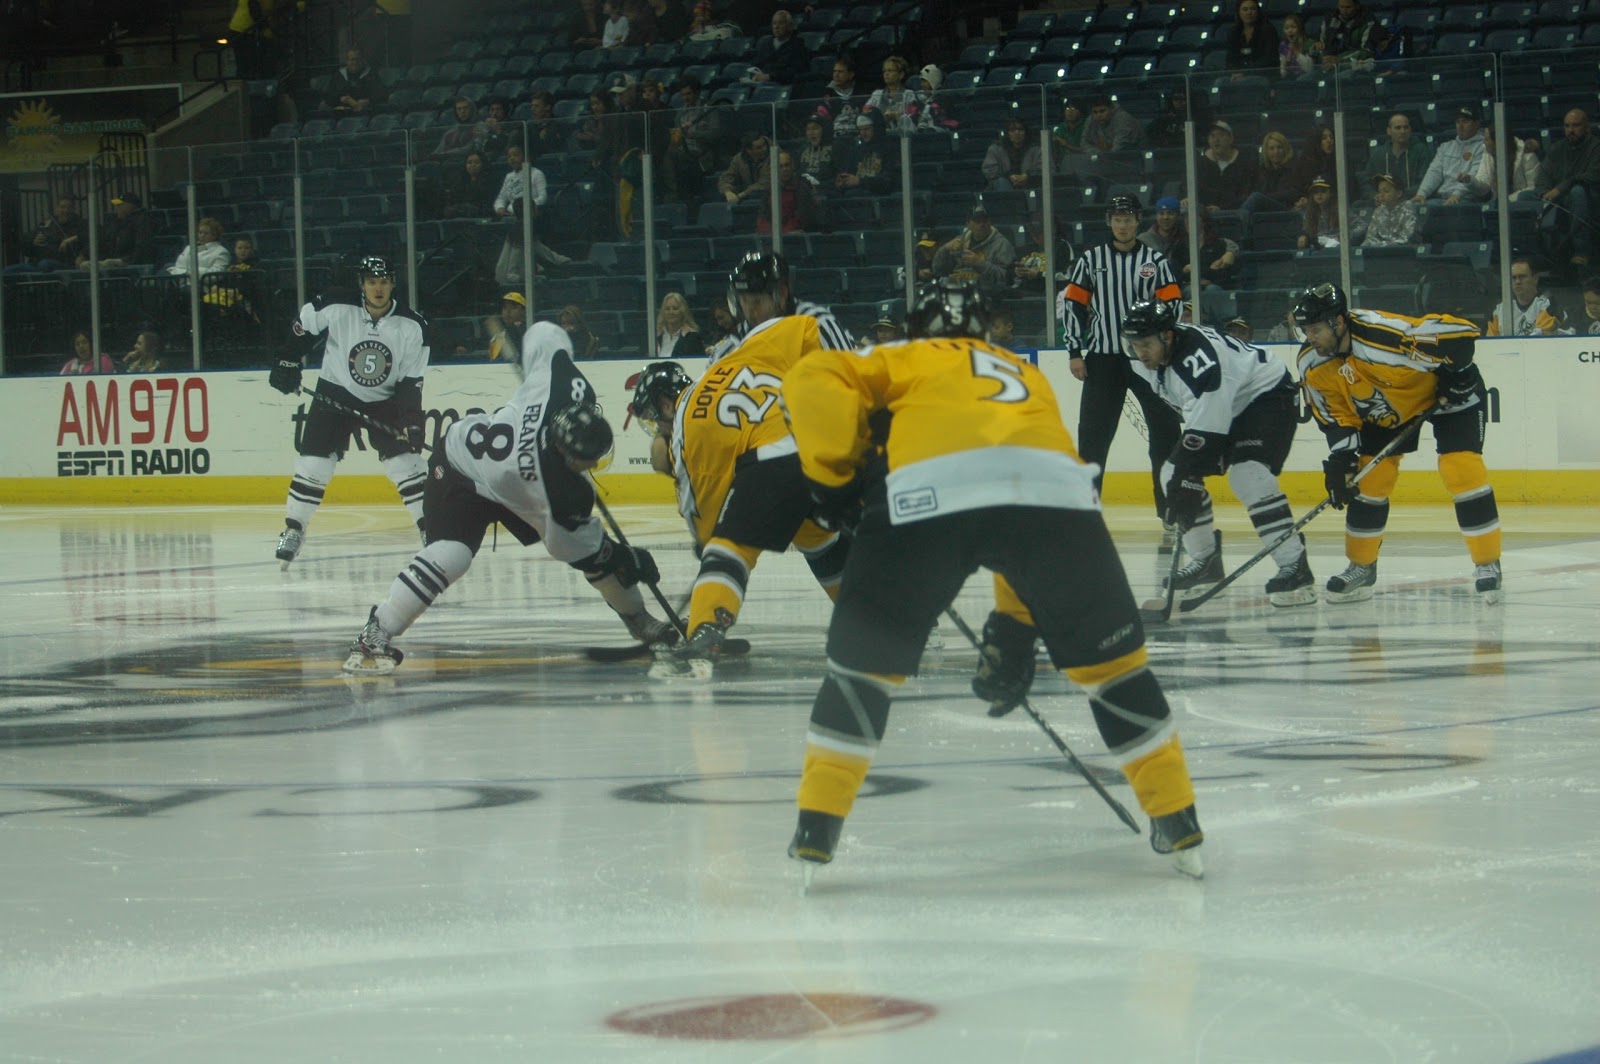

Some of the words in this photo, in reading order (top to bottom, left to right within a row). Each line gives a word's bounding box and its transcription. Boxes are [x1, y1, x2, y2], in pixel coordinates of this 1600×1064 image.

[63, 121, 91, 135] SAN
[355, 341, 368, 353] LAS
[369, 342, 390, 357] VEGAS
[364, 354, 377, 374] 5
[1182, 347, 1217, 379] 21
[350, 368, 388, 386] WRANGLERS
[571, 377, 587, 402] 8
[968, 349, 1029, 403] 5
[692, 366, 734, 419] DOYLE
[716, 365, 783, 430] 23
[56, 379, 120, 446] AM
[130, 377, 210, 444] 970
[465, 422, 514, 461] 8
[517, 403, 543, 482] FRANCIS
[57, 450, 125, 477] ESPN
[131, 447, 211, 476] RADIO
